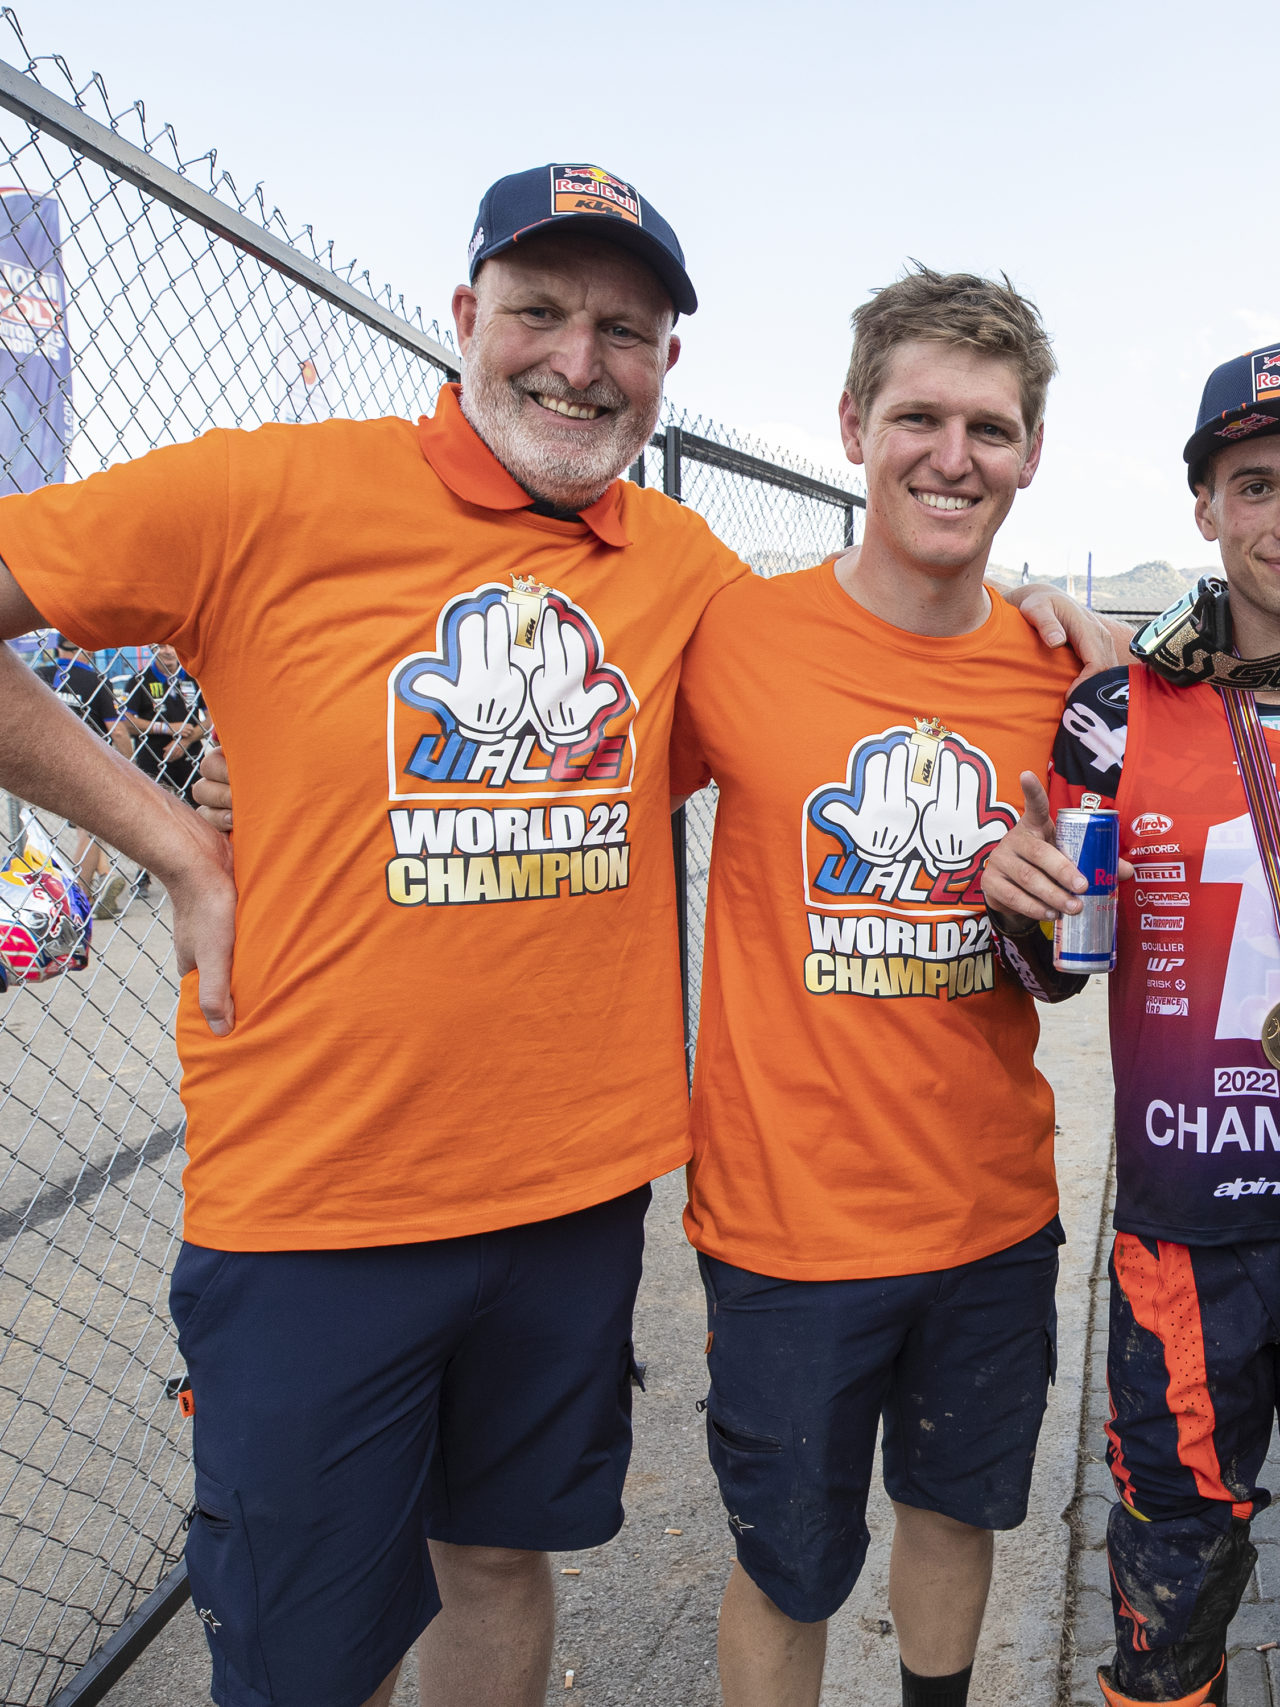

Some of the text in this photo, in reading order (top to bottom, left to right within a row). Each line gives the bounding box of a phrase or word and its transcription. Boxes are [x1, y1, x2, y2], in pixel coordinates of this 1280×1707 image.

[555, 179, 637, 214] Red Bull
[574, 199, 622, 217] KTM
[1135, 816, 1168, 831] Airoh
[1136, 844, 1180, 855] MOTOREX
[387, 844, 630, 906] CHAMPION
[1134, 866, 1181, 879] PIRELLI
[1147, 893, 1189, 901] COMISA
[1146, 957, 1186, 972] WP
[804, 952, 995, 1000] CHAMPION
[1217, 1071, 1277, 1094] 2022
